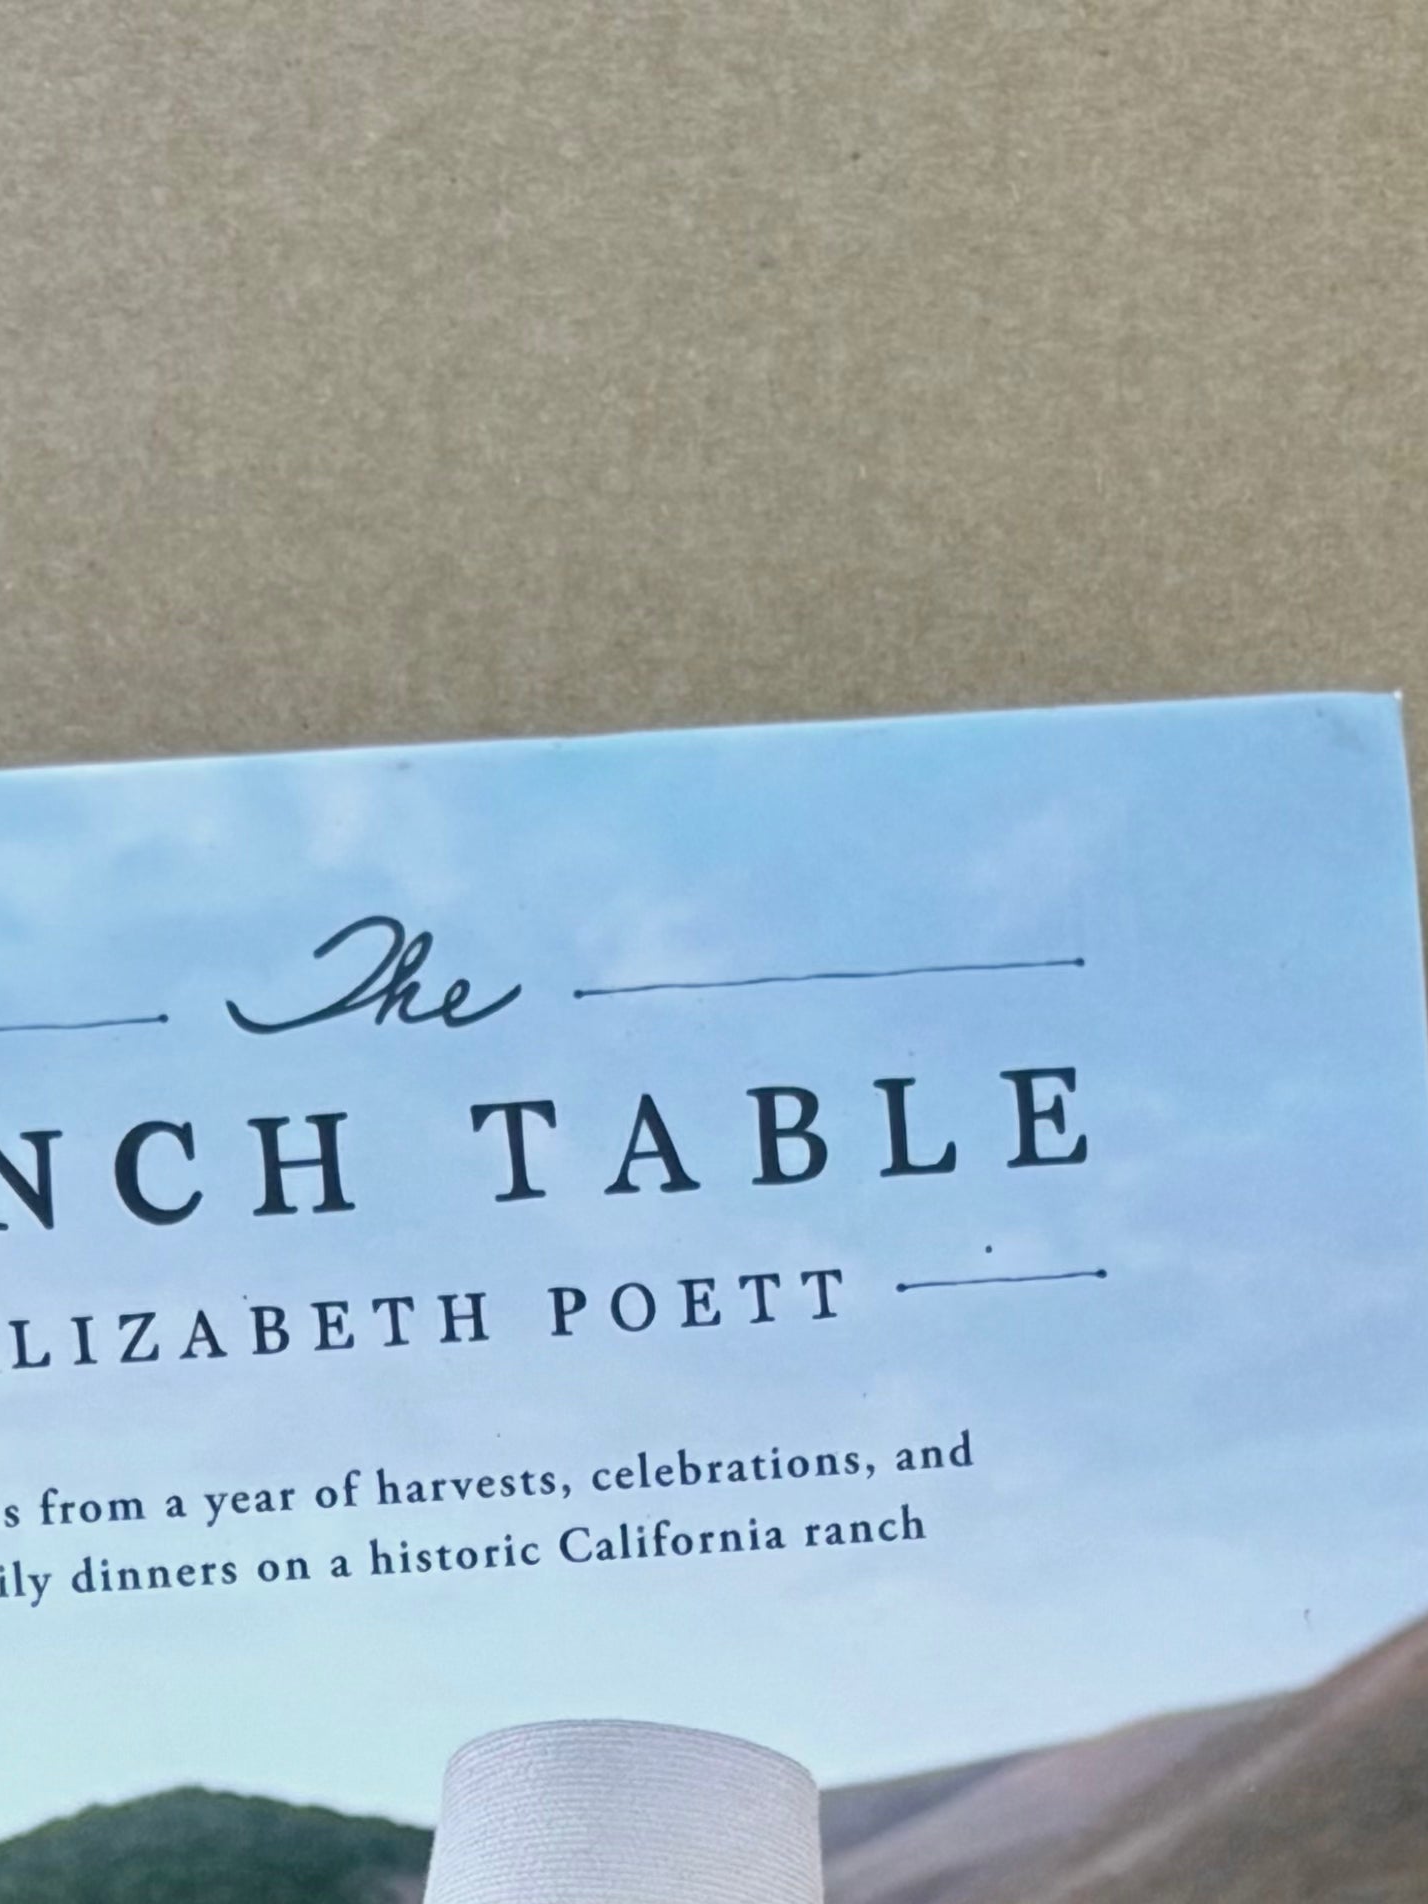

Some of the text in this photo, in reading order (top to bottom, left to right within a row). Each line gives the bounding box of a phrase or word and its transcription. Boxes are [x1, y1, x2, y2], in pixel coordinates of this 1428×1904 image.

[225, 914, 523, 1036] The
[469, 1065, 1089, 1203] TABLE
[546, 1268, 843, 1337] POETT
[38, 1486, 147, 1526] from
[165, 1494, 188, 1519] a
[203, 1487, 296, 1528] year
[314, 1468, 362, 1509] of
[375, 1466, 572, 1506] harvests,
[591, 1446, 876, 1492] celebrations,
[895, 1428, 975, 1472] and
[70, 1555, 238, 1594] dinners
[256, 1556, 312, 1583] on
[330, 1554, 353, 1579] a
[368, 1533, 541, 1576] historic
[558, 1517, 787, 1564] California
[804, 1502, 927, 1548] ranch
